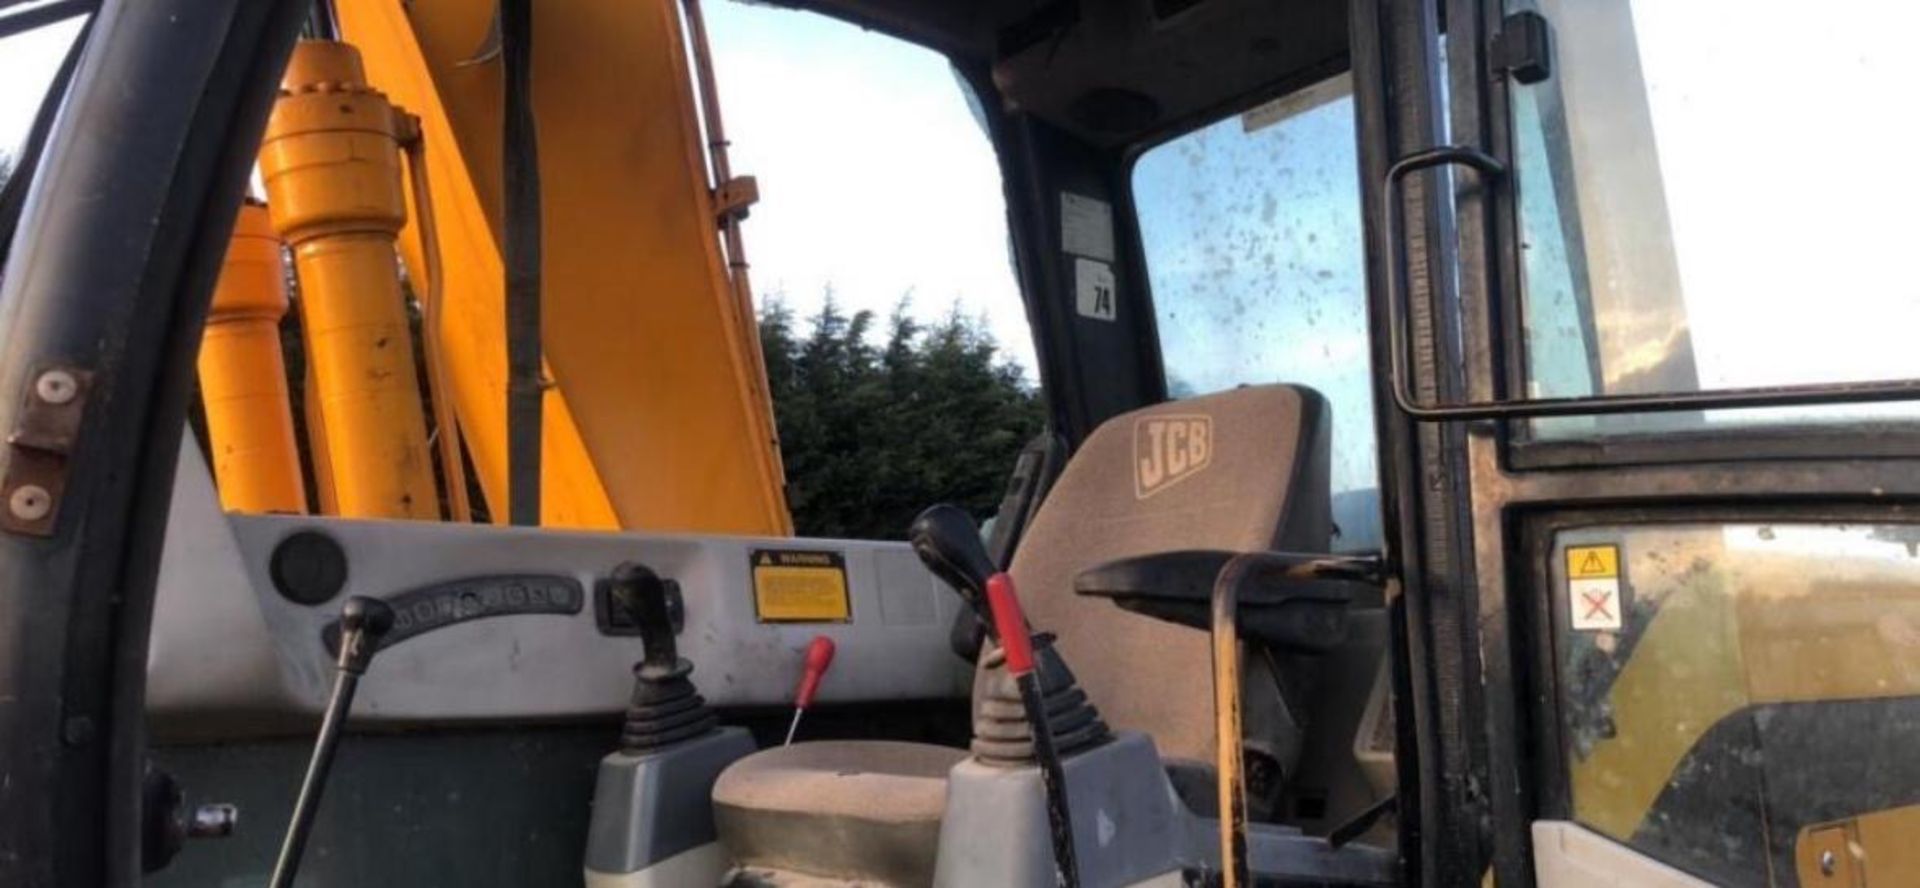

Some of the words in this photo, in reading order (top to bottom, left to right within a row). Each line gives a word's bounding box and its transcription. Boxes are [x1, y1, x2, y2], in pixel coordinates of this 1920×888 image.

[1094, 285, 1110, 315] 74
[1140, 421, 1206, 488] JCB
[780, 553, 830, 565] WARNING
